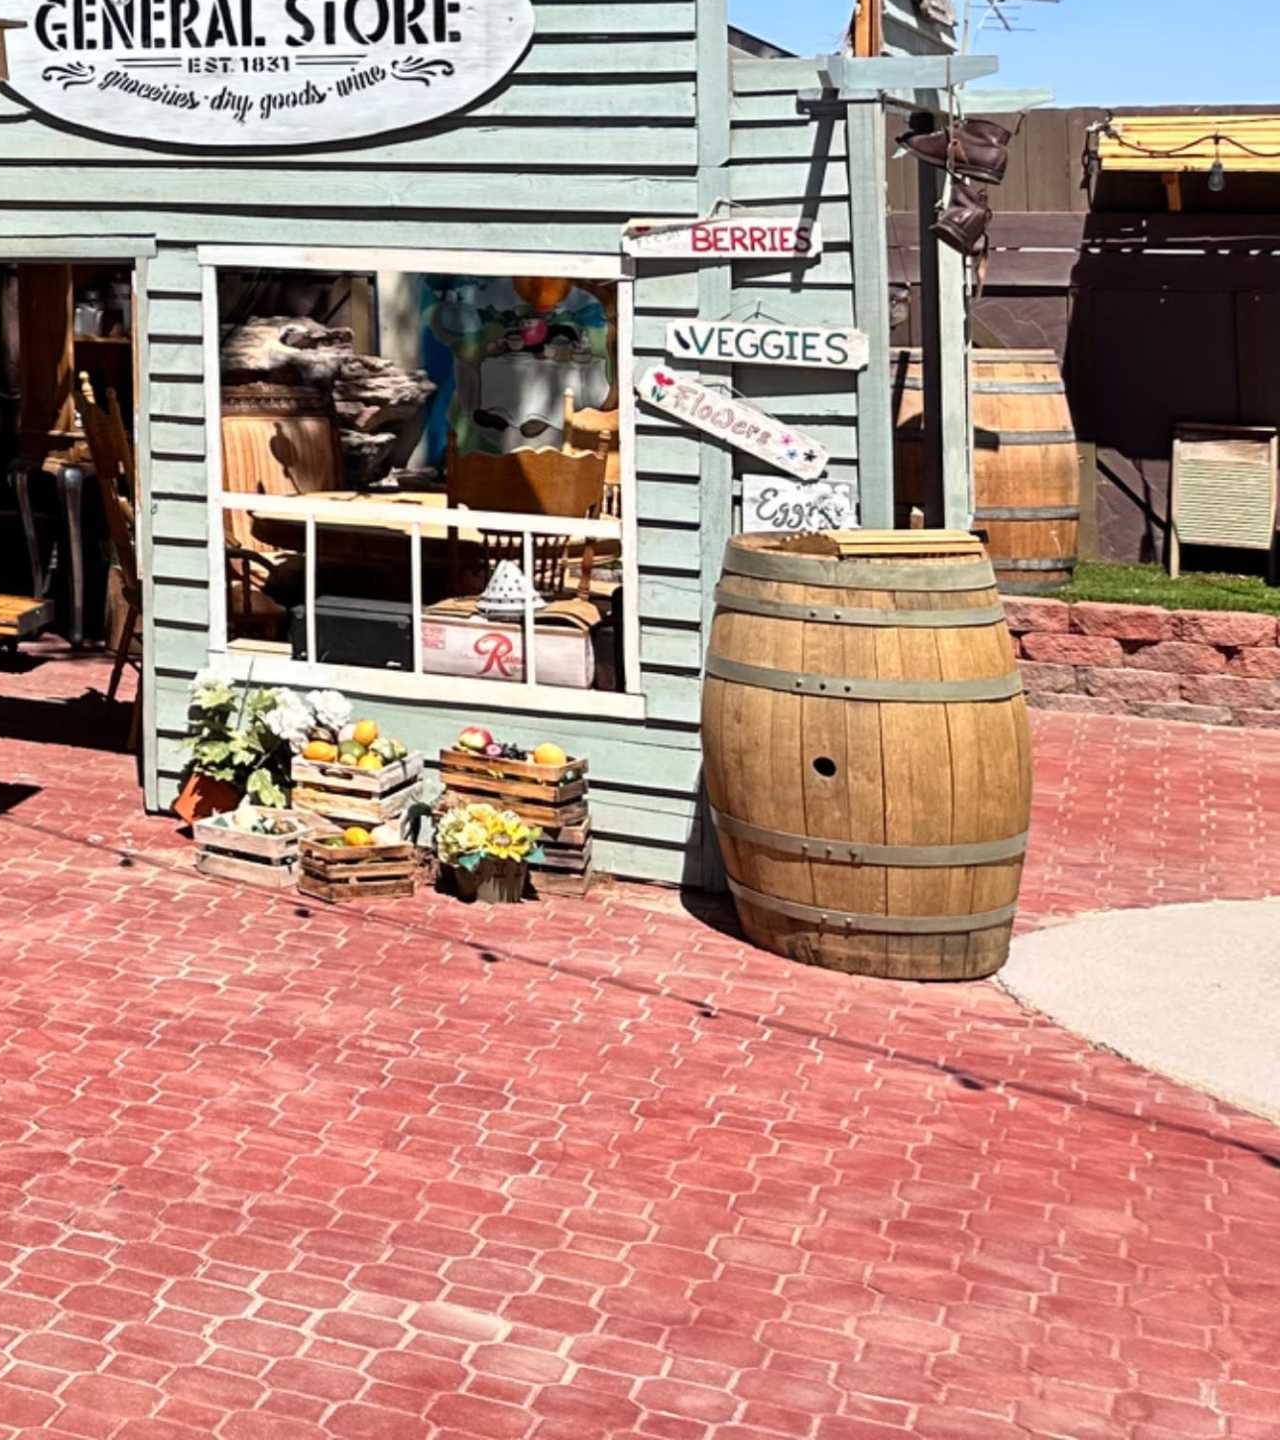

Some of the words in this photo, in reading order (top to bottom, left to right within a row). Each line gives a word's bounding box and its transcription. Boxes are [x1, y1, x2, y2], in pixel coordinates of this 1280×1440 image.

[188, 56, 236, 74] EST.
[242, 55, 291, 73] 1831
[96, 69, 201, 110] groceries
[209, 85, 254, 123] dry
[259, 79, 328, 120] goods
[335, 64, 387, 98] wine
[691, 224, 813, 254] BERRIES
[689, 325, 850, 365] VEGGIES
